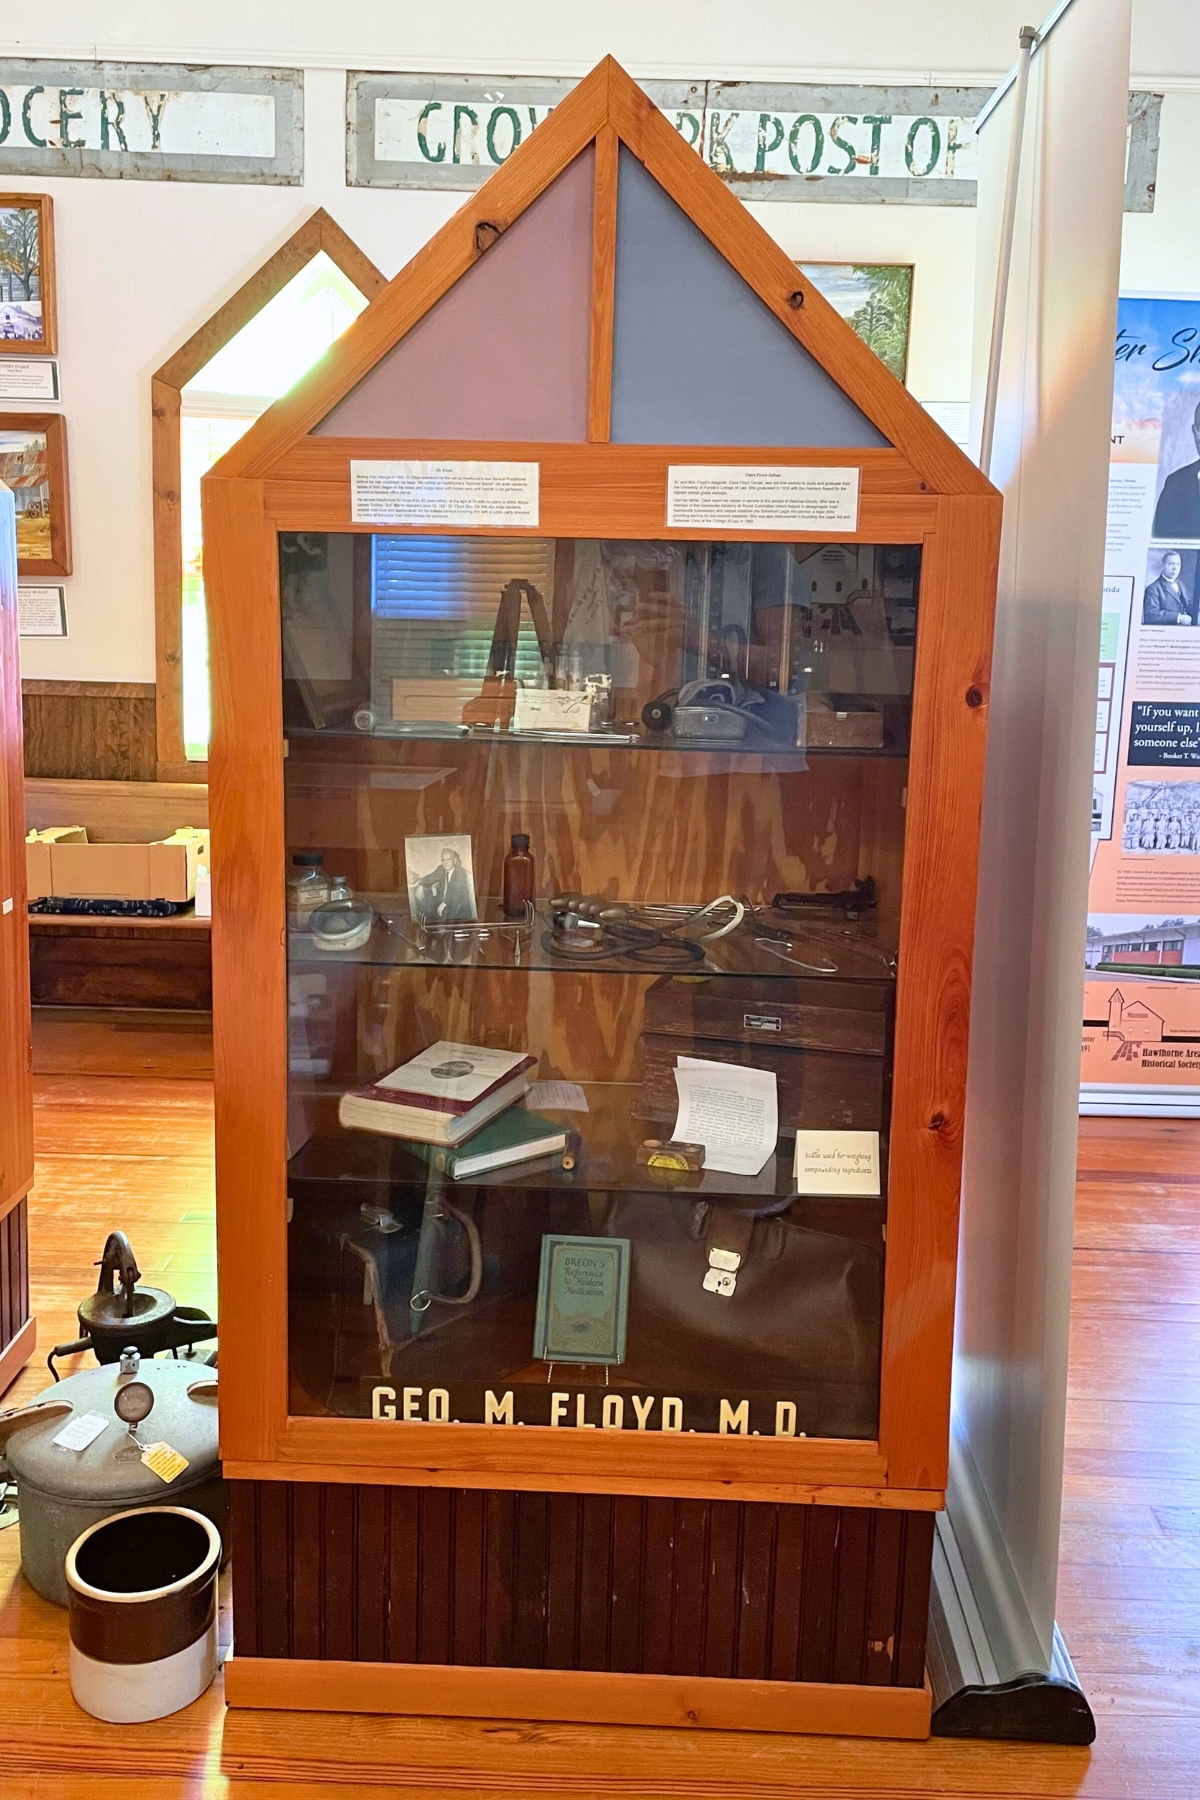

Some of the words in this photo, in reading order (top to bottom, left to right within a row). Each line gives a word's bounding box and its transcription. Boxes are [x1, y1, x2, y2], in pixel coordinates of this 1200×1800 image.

[755, 113, 892, 175] POST
[1152, 710, 1172, 719] you
[1135, 721, 1176, 734] yourself
[1178, 725, 1193, 735] up,
[1143, 1048, 1183, 1057] Hawthorne
[823, 1149, 838, 1158] used
[847, 1152, 871, 1165] weighing
[805, 1166, 840, 1175] compounding
[565, 1258, 605, 1268] BREON'S
[565, 1267, 603, 1277] Reference
[574, 1278, 604, 1287] Modern
[563, 1287, 604, 1297] Medication
[372, 1386, 460, 1424] GEO.
[485, 1390, 524, 1426] M.
[719, 1399, 760, 1436] M.
[776, 1401, 806, 1438] D.
